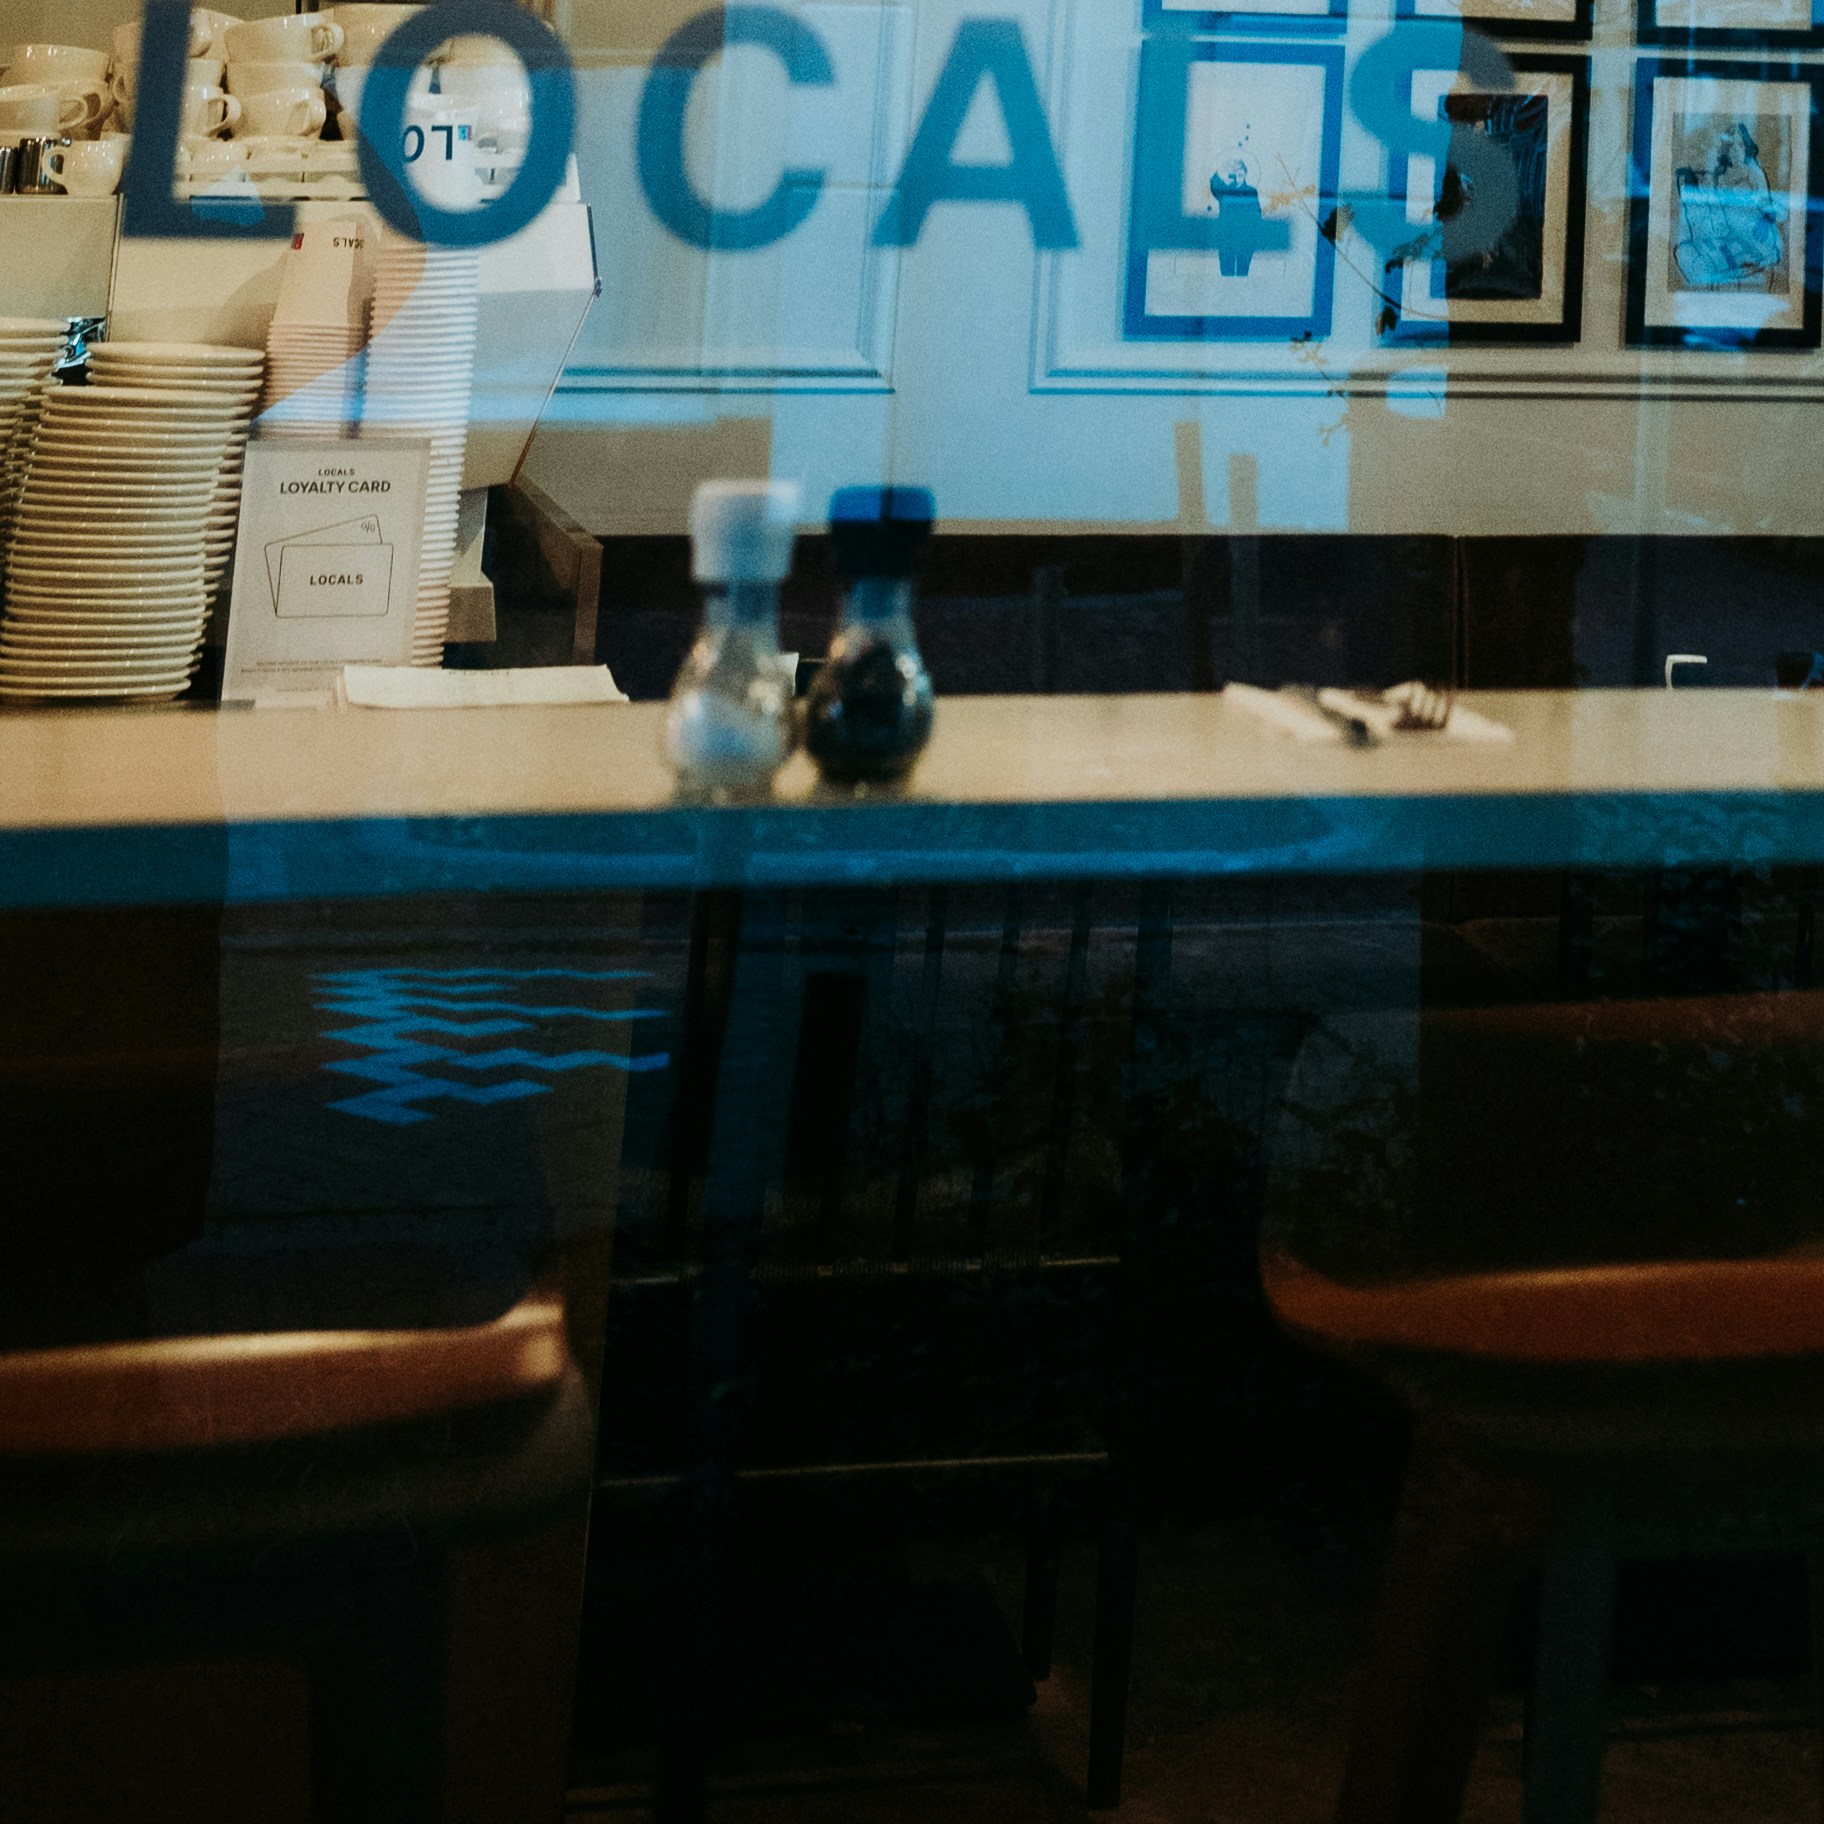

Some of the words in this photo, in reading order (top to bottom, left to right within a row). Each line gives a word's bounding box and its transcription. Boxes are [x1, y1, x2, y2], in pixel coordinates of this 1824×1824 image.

[318, 468, 355, 476] LOCALS
[280, 481, 345, 494] LOYALTY
[348, 481, 391, 493] CARD
[310, 574, 364, 586] LOCALS
